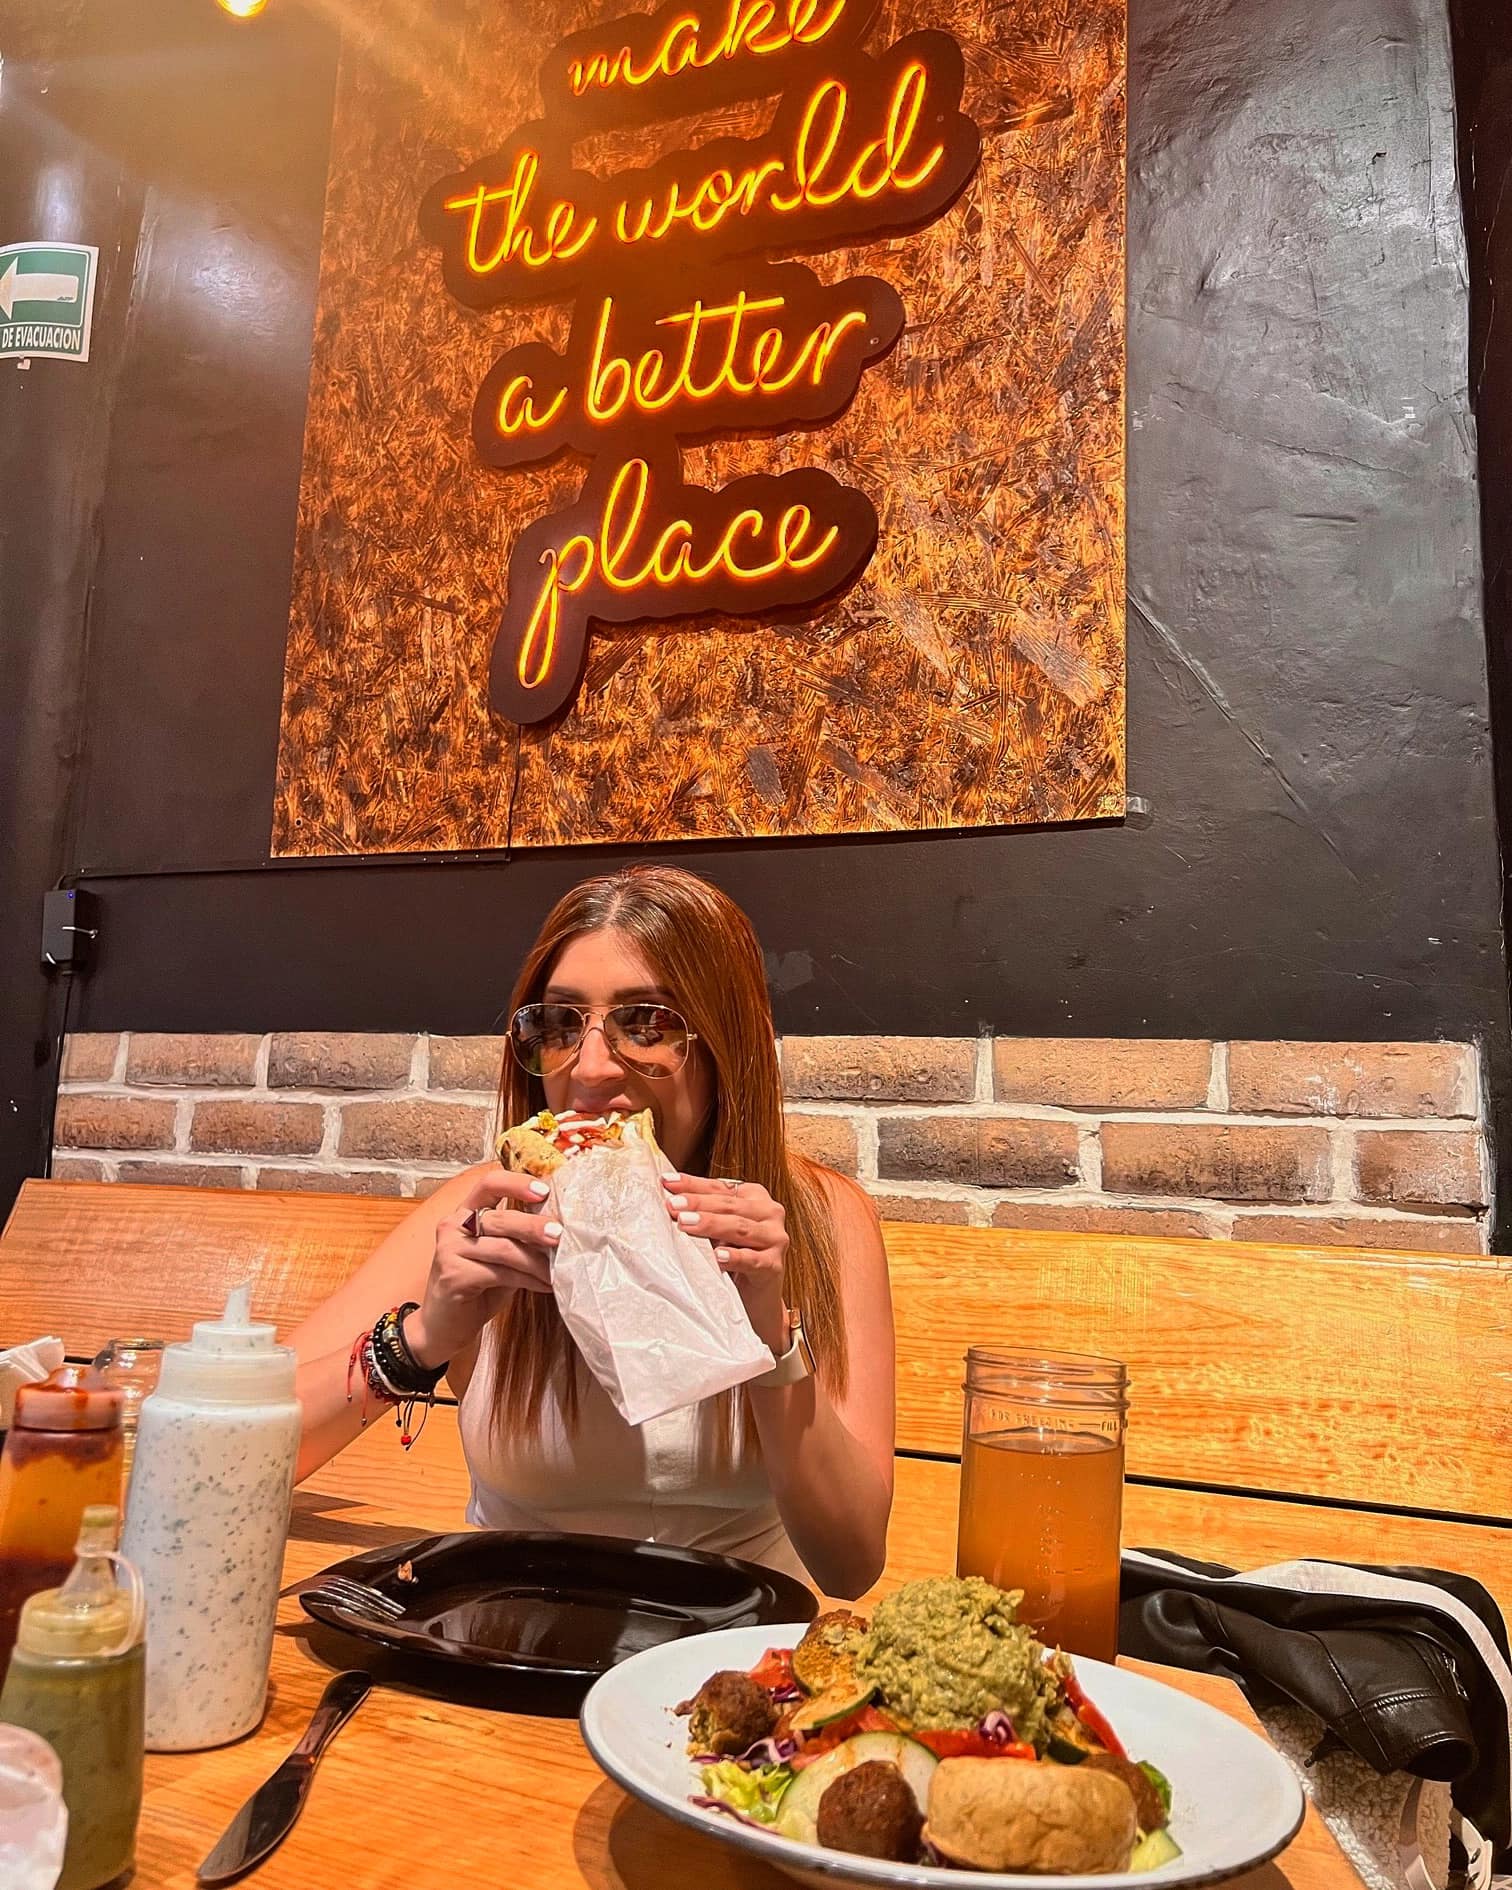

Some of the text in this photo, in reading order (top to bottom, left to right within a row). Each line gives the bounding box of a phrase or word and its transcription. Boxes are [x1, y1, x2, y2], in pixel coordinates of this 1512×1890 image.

[567, 0, 847, 95] make
[446, 63, 945, 274] the world
[2, 326, 81, 350] DE EVACUACION
[498, 291, 867, 433] a better
[519, 458, 839, 689] place
